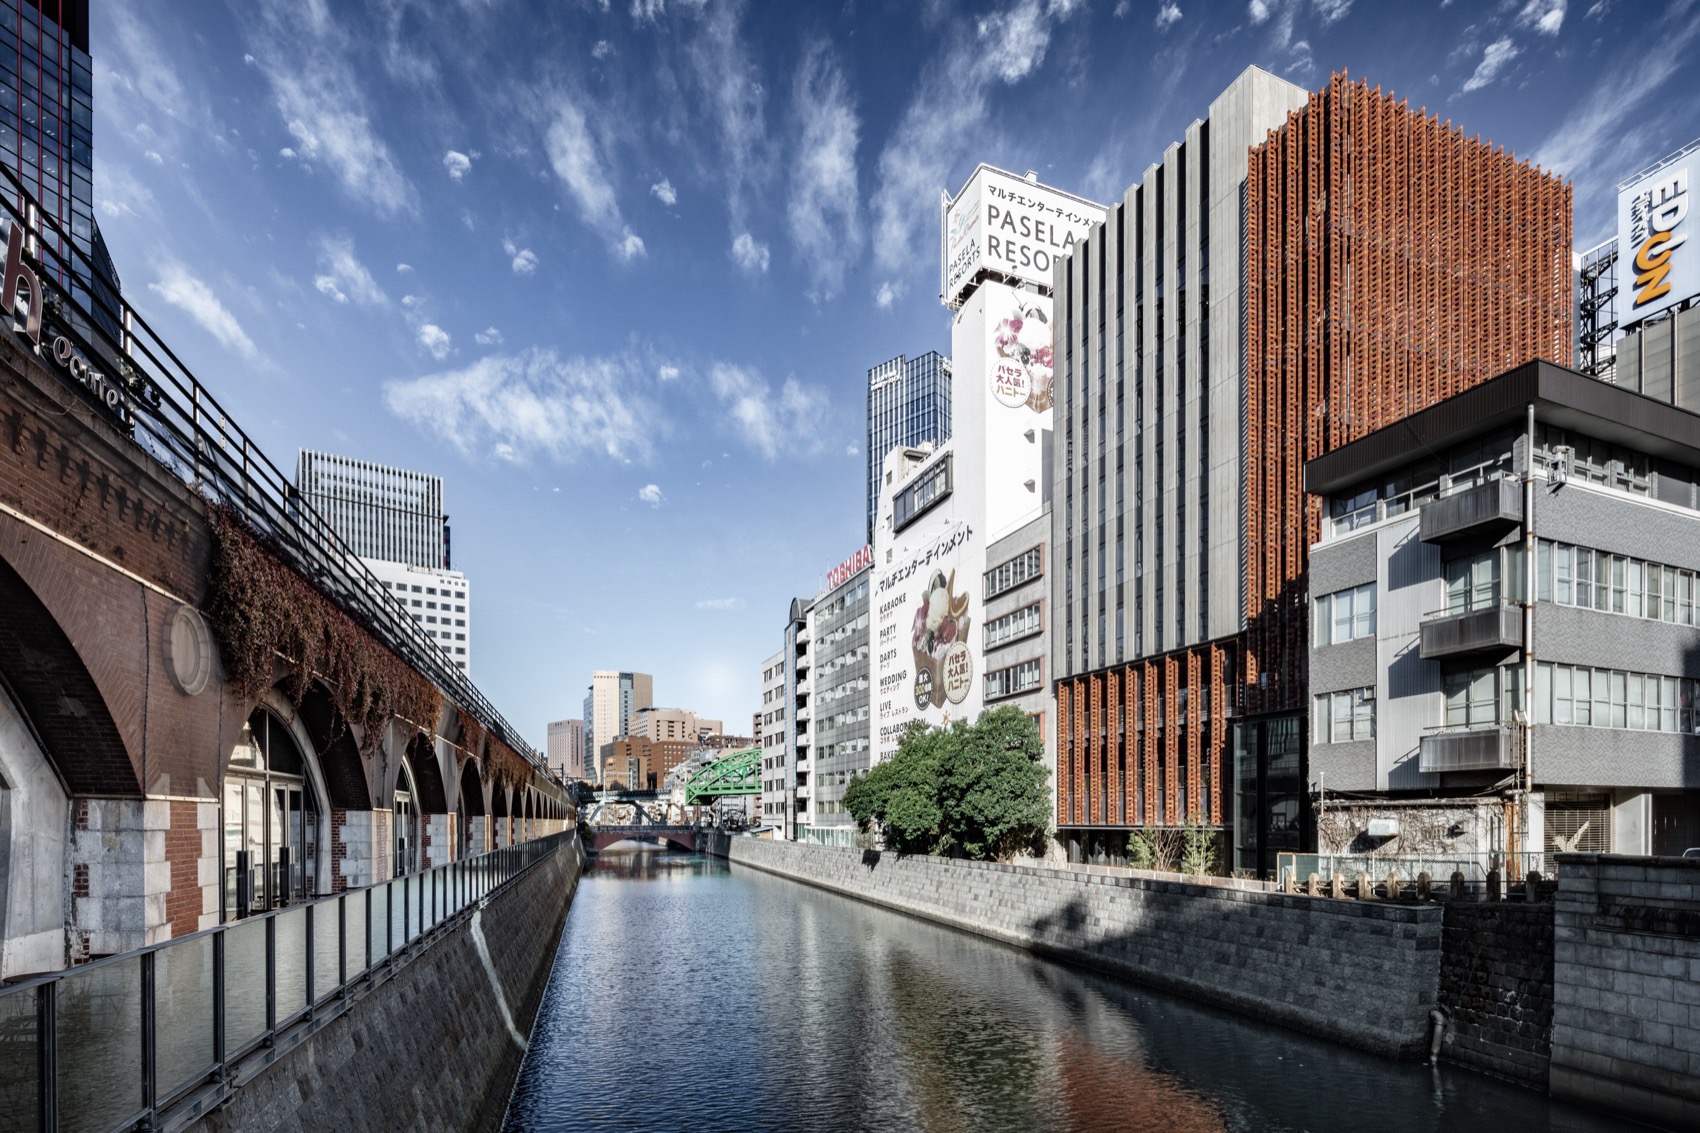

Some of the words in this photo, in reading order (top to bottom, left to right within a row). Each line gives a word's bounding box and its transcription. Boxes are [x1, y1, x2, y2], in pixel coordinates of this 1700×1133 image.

[988, 205, 1075, 250] PASELA
[949, 238, 976, 275] PASELA
[949, 246, 981, 290] RESORTS
[52, 336, 119, 410] ecute
[996, 385, 1026, 398] ハニトー
[827, 544, 871, 591] TOSHIBA
[879, 525, 973, 592] マルチエンターテインメント
[879, 592, 906, 615] KARAOKE
[879, 623, 897, 640] PARTY
[879, 648, 897, 663] DARTS
[879, 669, 907, 687] WEDDING
[879, 700, 892, 712] LIVE
[918, 694, 929, 704] OK!
